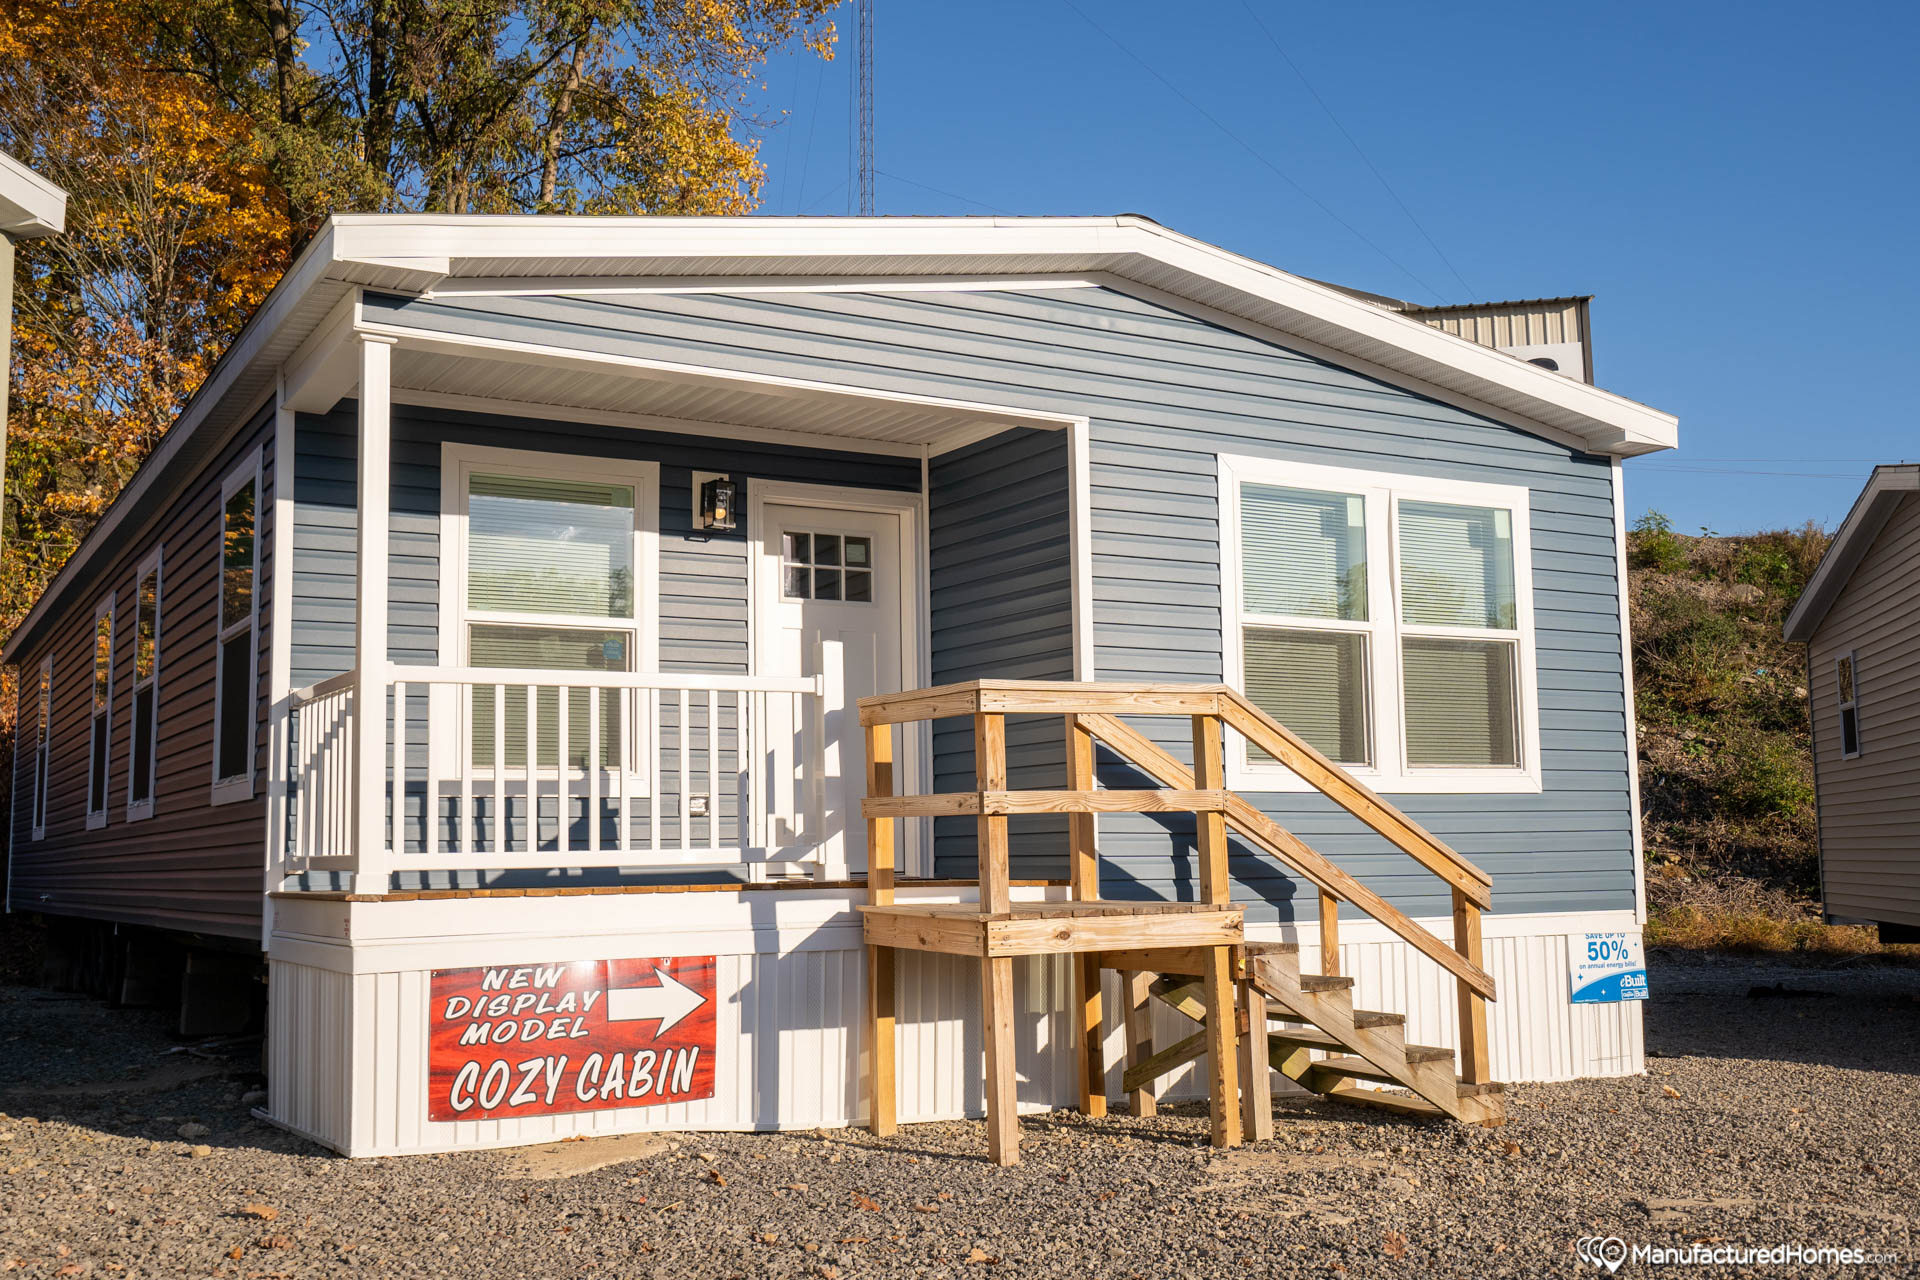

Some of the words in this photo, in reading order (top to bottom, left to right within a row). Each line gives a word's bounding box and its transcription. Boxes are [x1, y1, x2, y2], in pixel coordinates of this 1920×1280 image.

[1585, 932, 1603, 940] SAVE
[1587, 939, 1629, 961] 50%
[481, 966, 566, 991] NEW
[1620, 974, 1647, 988] eBuilt
[444, 990, 601, 1020] DISPLAY
[458, 1016, 590, 1046] MODEL
[450, 1054, 569, 1112] COZY
[575, 1045, 701, 1102] CABIN
